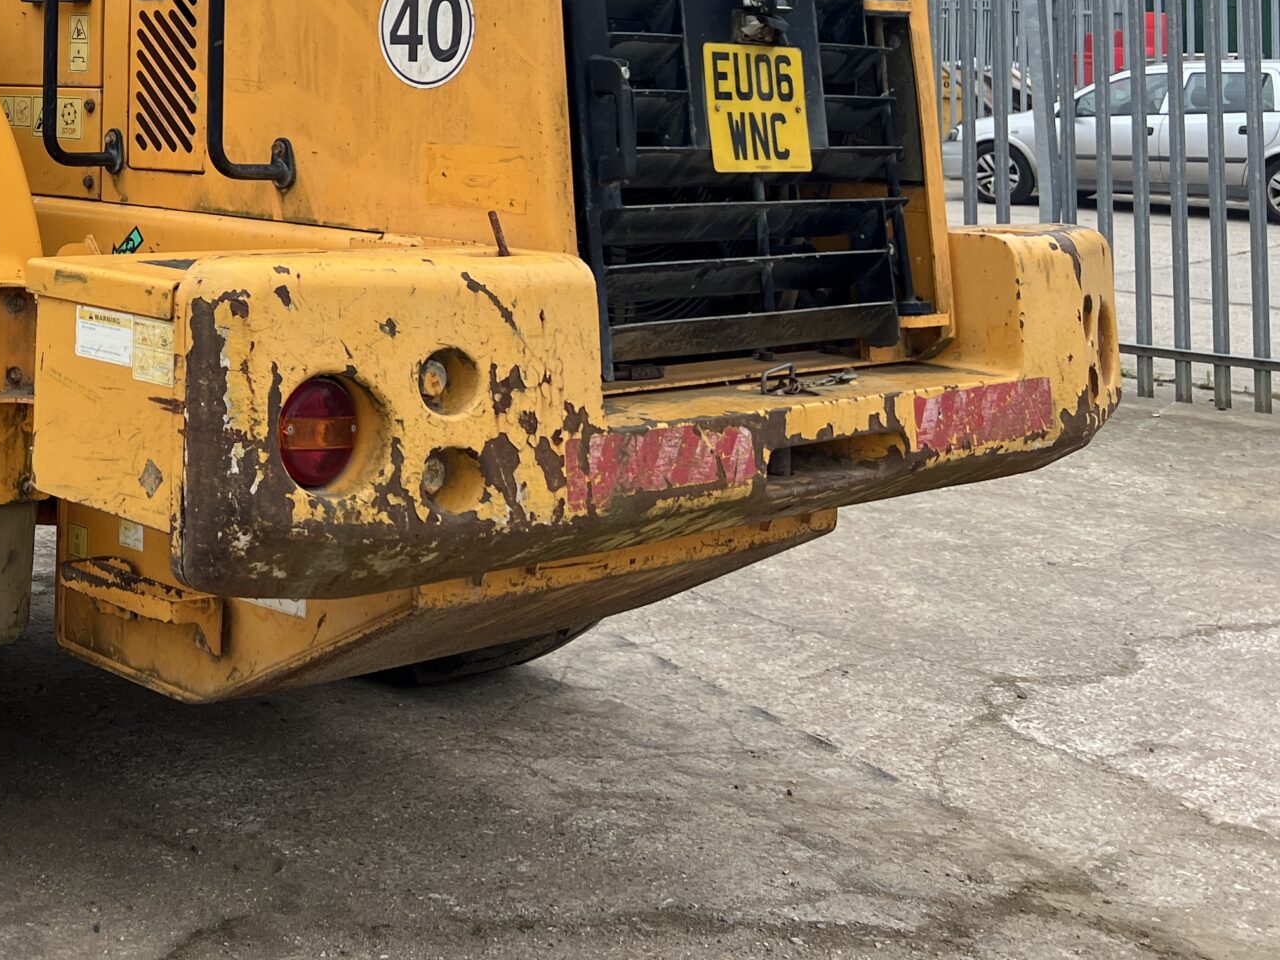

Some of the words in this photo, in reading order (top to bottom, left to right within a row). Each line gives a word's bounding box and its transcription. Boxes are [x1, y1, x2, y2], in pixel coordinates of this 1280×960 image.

[711, 52, 794, 102] EU06
[61, 127, 77, 135] STOP
[727, 112, 791, 161] WNC
[94, 313, 121, 325] WARNING
